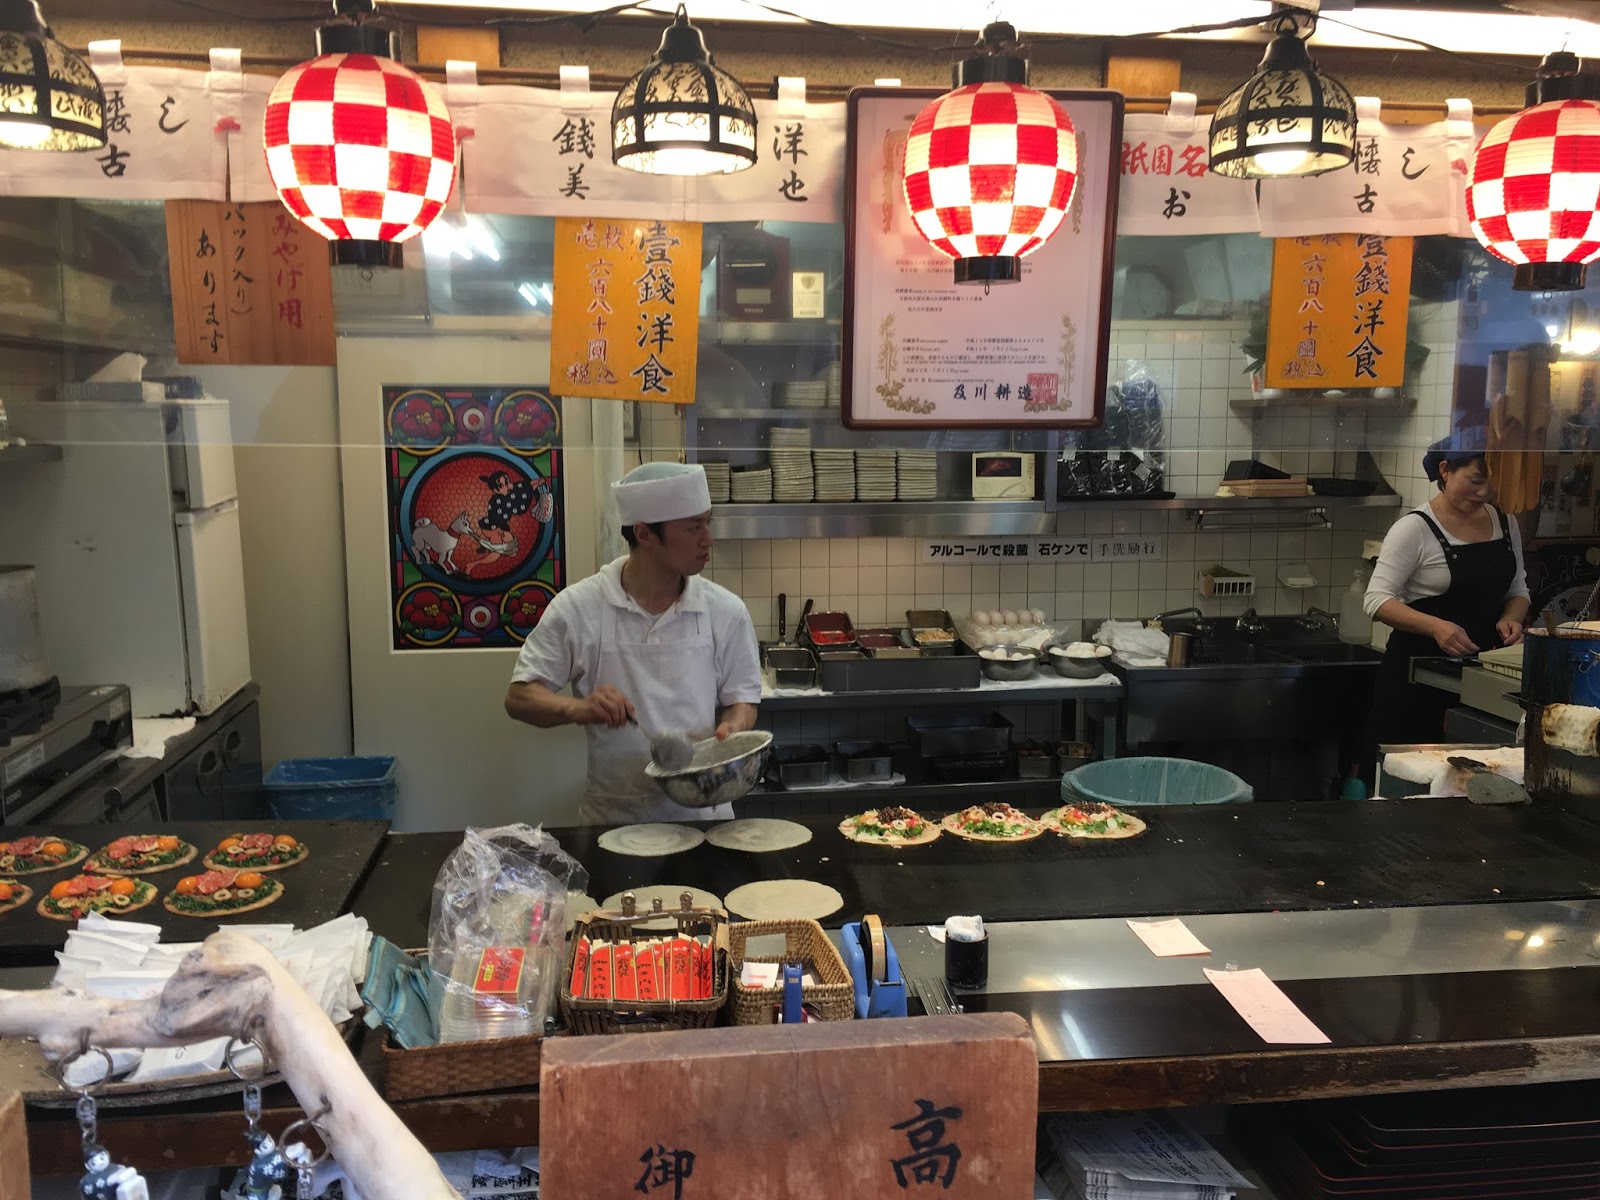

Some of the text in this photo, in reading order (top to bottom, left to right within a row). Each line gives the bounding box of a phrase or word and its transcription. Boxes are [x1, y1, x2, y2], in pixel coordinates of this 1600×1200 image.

[1163, 187, 1191, 220] お
[197, 228, 224, 353] あります
[269, 203, 304, 329] みやげ用
[929, 543, 1029, 558] アルコールで殺菌
[1038, 542, 1089, 556] 石ケンで
[634, 1143, 698, 1200] 御
[889, 1098, 963, 1191] 高
